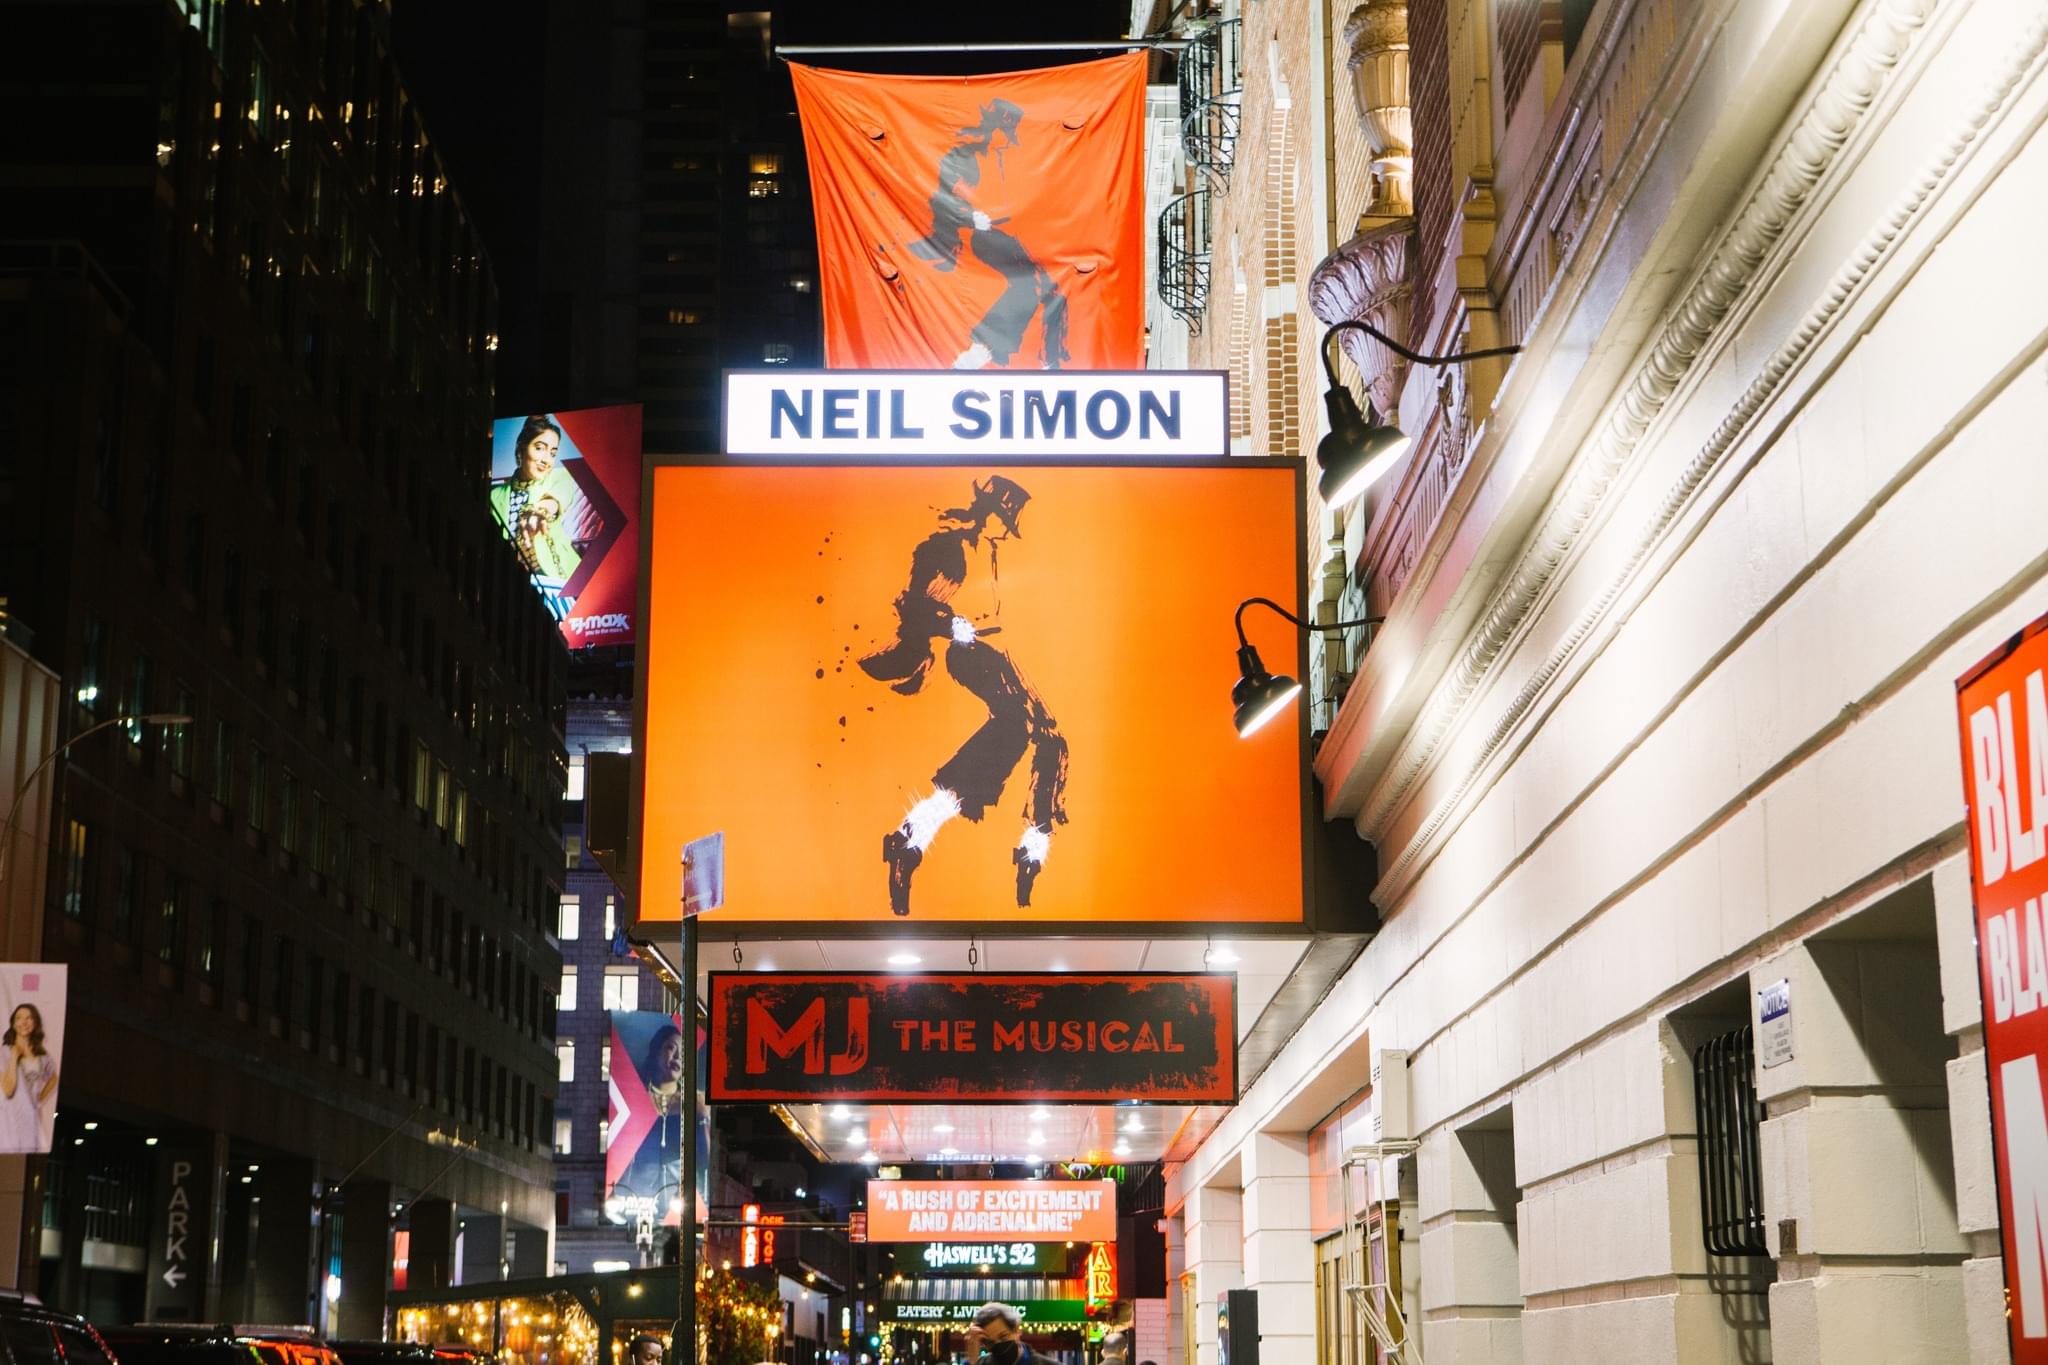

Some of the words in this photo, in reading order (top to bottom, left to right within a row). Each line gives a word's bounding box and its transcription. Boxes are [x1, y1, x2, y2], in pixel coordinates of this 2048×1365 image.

[770, 388, 924, 440] NEIL
[948, 388, 1181, 440] SIMON
[1986, 889, 2048, 1024] BLA
[1760, 987, 1789, 1017] NOTICE
[745, 996, 870, 1076] MJ
[892, 1020, 977, 1052] THE
[993, 1020, 1185, 1053] MUSICAL
[166, 1161, 191, 1261] PARK
[902, 1188, 951, 1211] RUSH
[957, 1190, 980, 1211] OF
[984, 1190, 1103, 1211] EXCITEMENT
[909, 1211, 949, 1233] AND
[1009, 1243, 1036, 1265] 52
[1092, 1242, 1114, 1297] AR
[897, 1305, 945, 1318] EATERY
